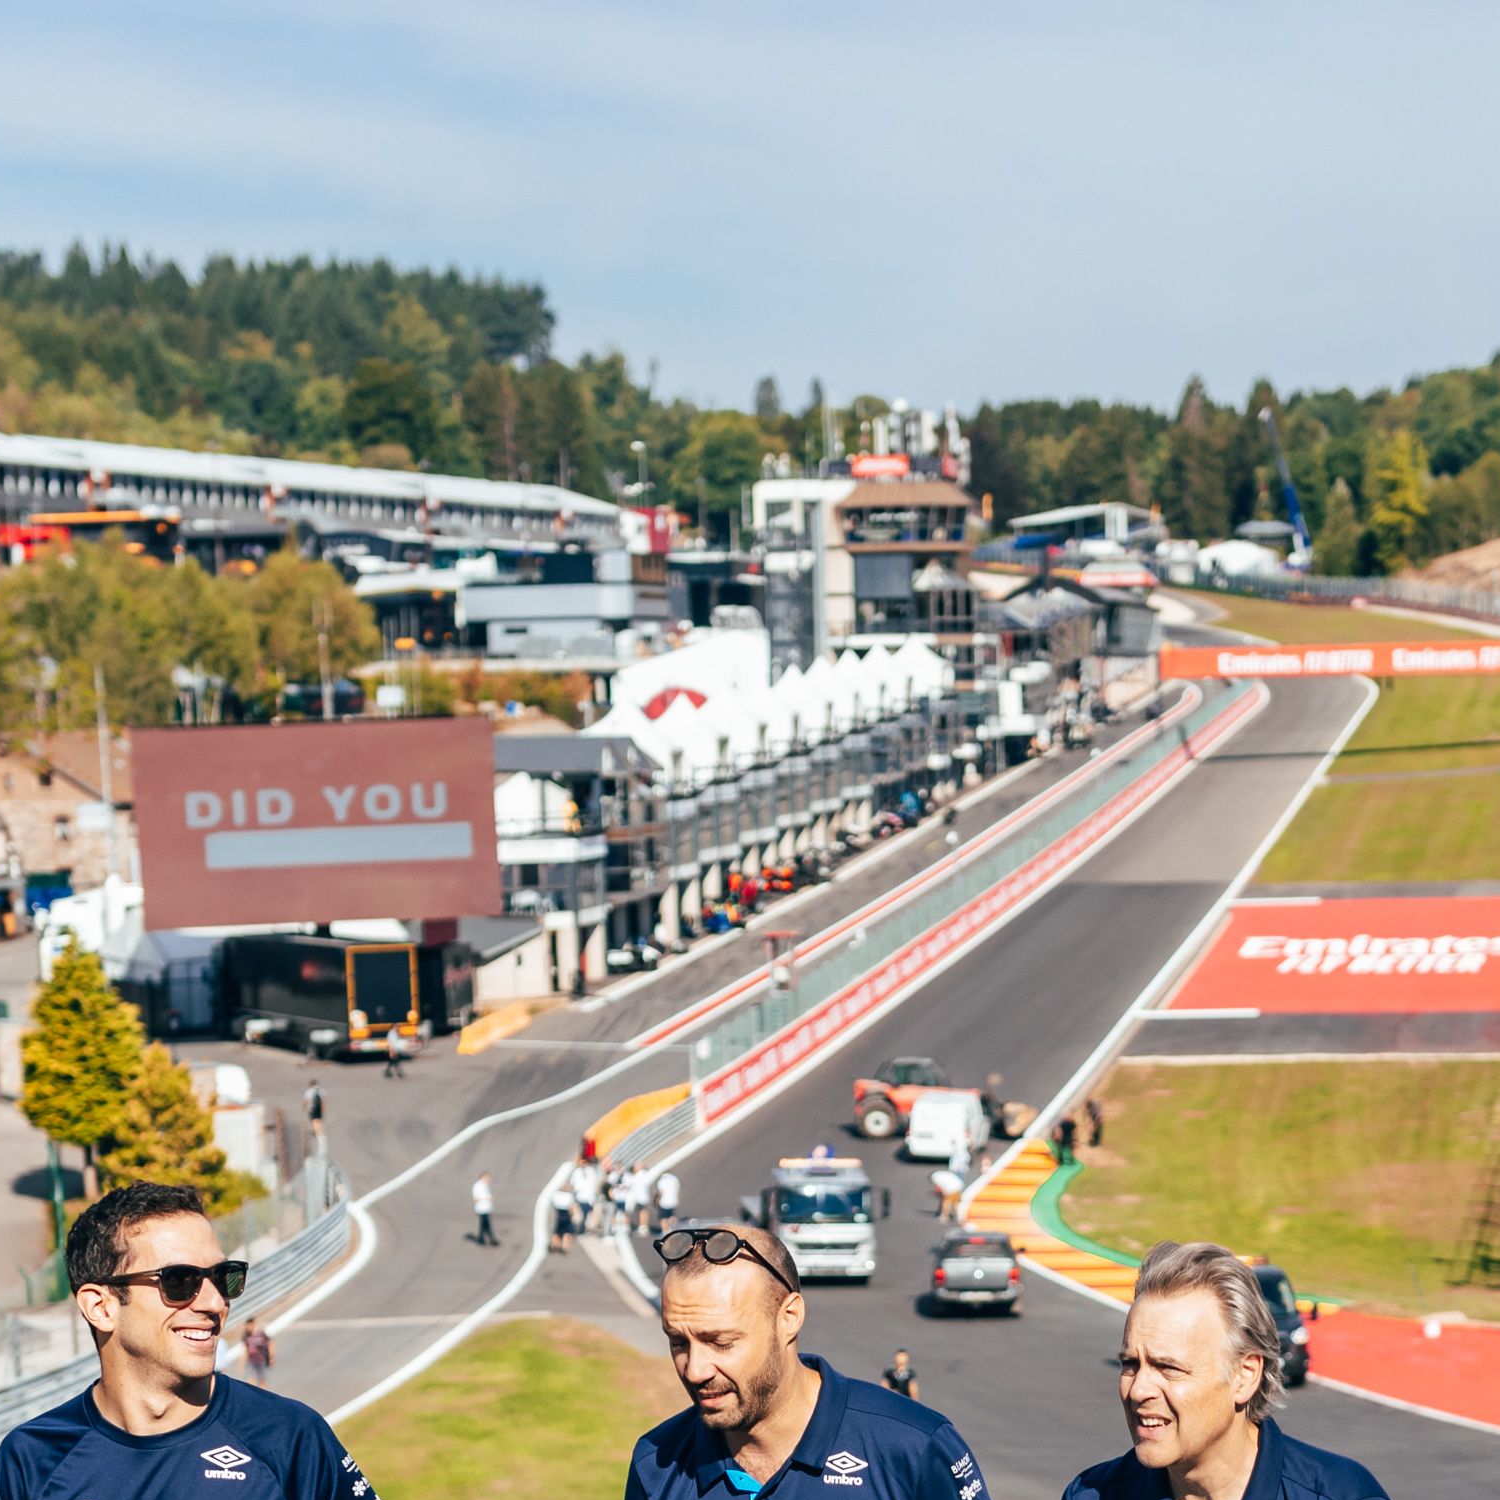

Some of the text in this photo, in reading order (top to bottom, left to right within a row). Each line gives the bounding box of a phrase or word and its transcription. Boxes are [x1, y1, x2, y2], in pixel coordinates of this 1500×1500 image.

[184, 781, 447, 829] DID YOU
[204, 1469, 246, 1481] umbro
[823, 1474, 863, 1486] umbro
